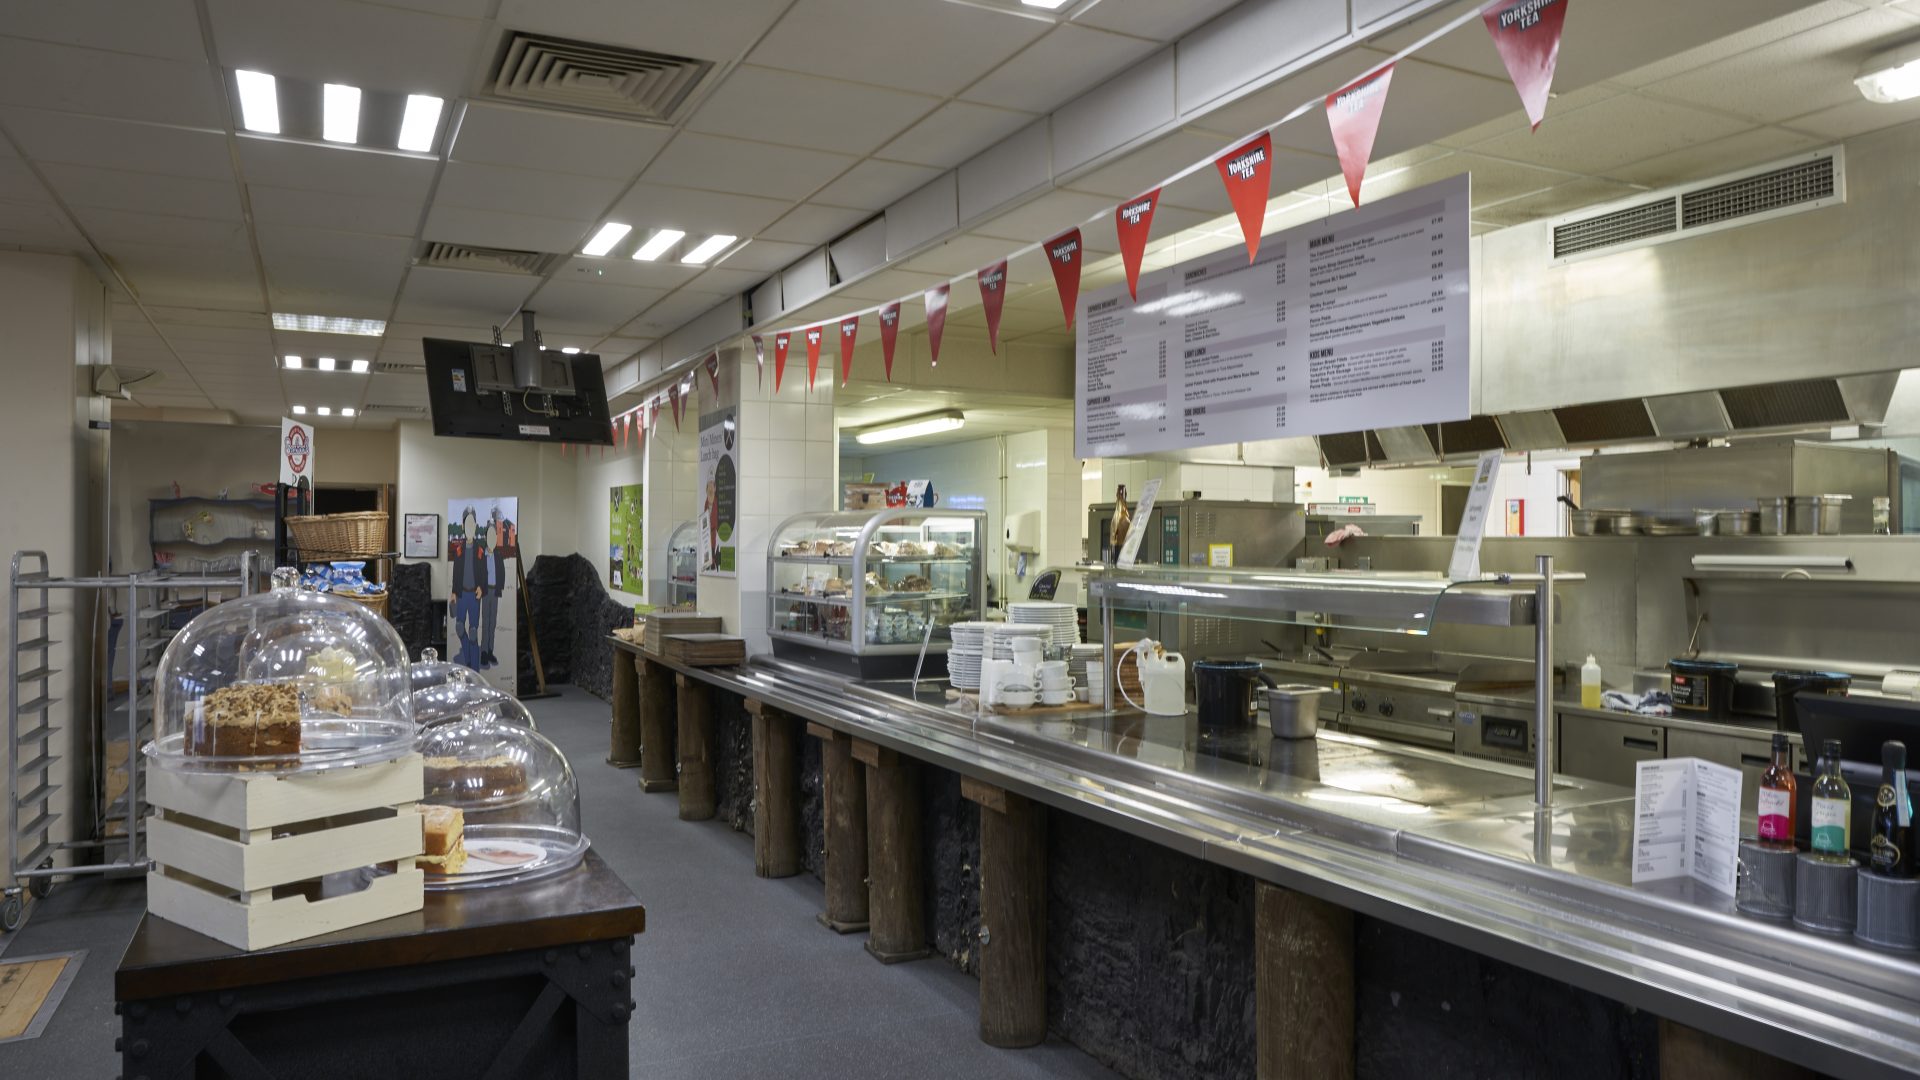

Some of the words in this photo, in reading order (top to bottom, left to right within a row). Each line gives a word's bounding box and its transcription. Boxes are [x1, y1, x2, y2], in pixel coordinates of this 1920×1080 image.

[1520, 11, 1539, 29] TEA
[1228, 149, 1265, 176] YORKSHIRE
[1241, 165, 1255, 180] TEA
[1122, 200, 1151, 220] YORKSHIRE
[1130, 213, 1140, 225] TEA
[1310, 238, 1320, 249] MAIN
[1322, 234, 1334, 245] MENU
[1053, 240, 1077, 259] YORKSHIRE
[1062, 252, 1071, 263] TEA
[1195, 347, 1206, 356] LUNCH
[1310, 350, 1320, 360] KIDS
[1321, 348, 1333, 358] MENU
[1193, 406, 1206, 416] ORDERS
